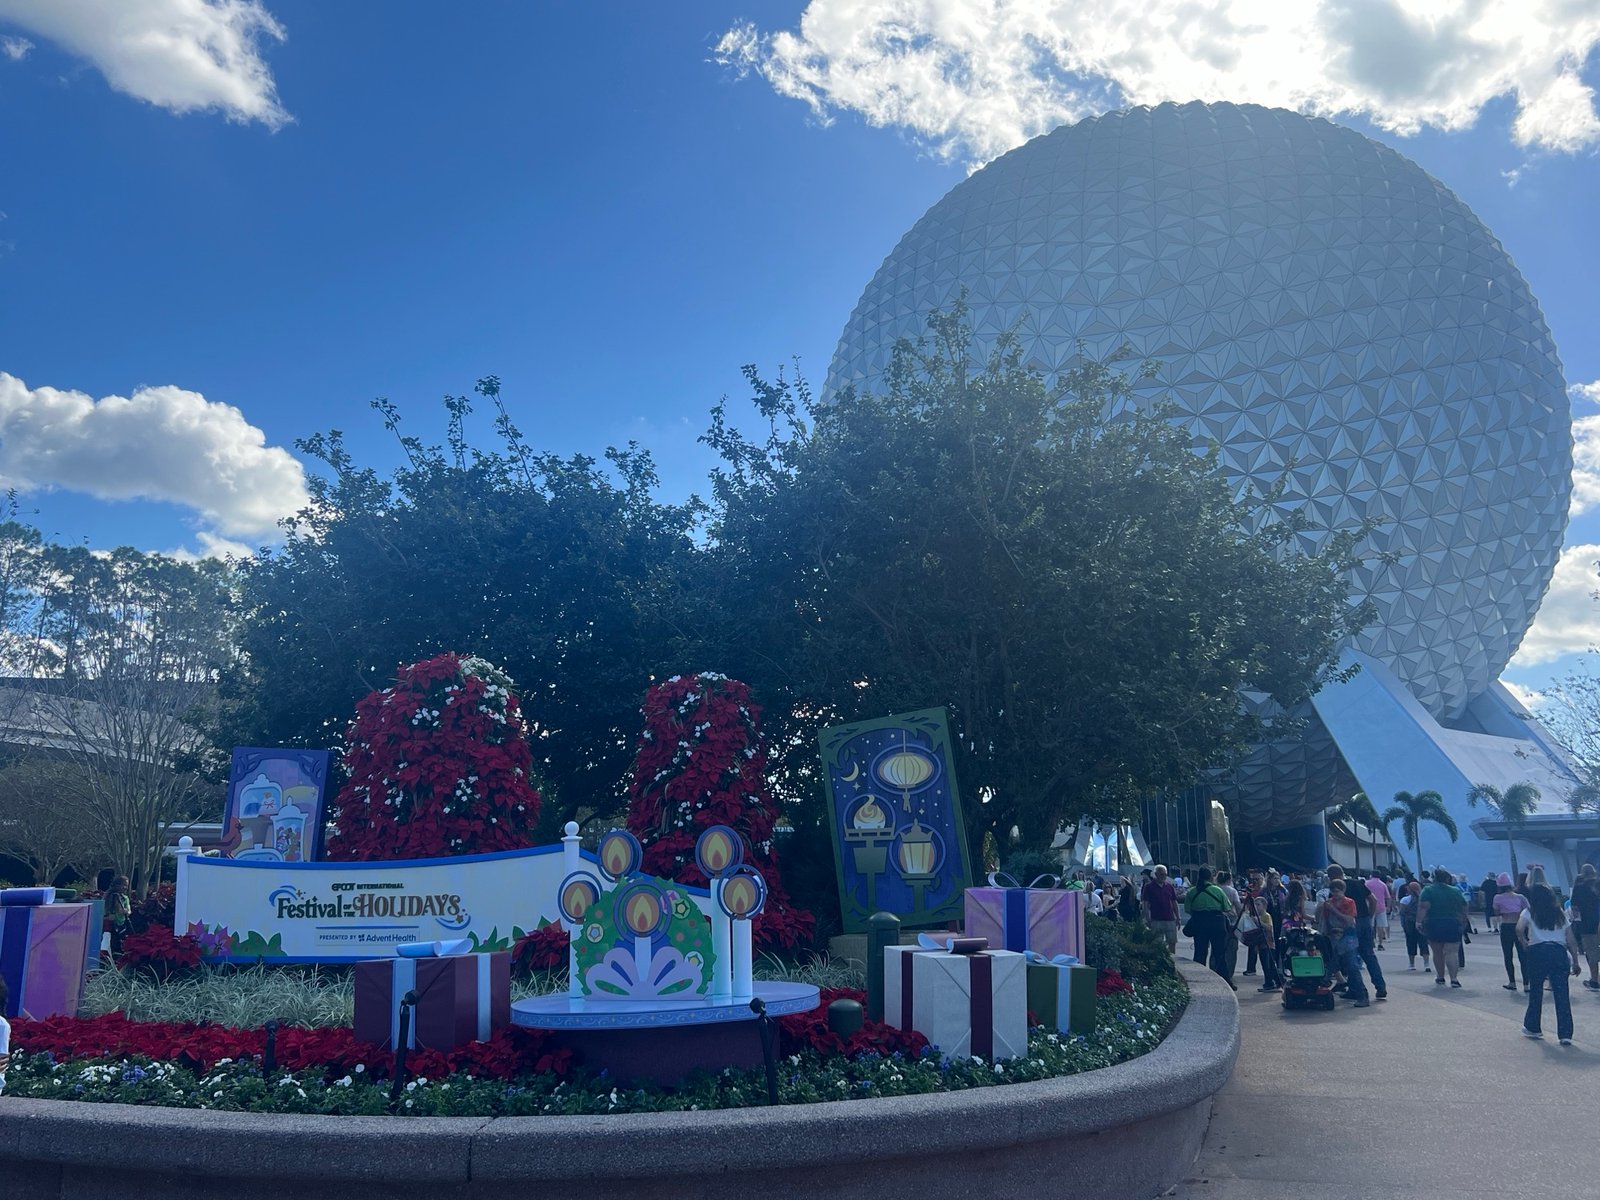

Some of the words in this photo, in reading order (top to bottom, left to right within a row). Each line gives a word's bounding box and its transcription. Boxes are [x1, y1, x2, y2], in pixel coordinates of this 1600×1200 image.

[331, 883, 355, 891] EPCOT
[276, 894, 343, 919] Festival
[353, 893, 461, 918] HOLIDAYS
